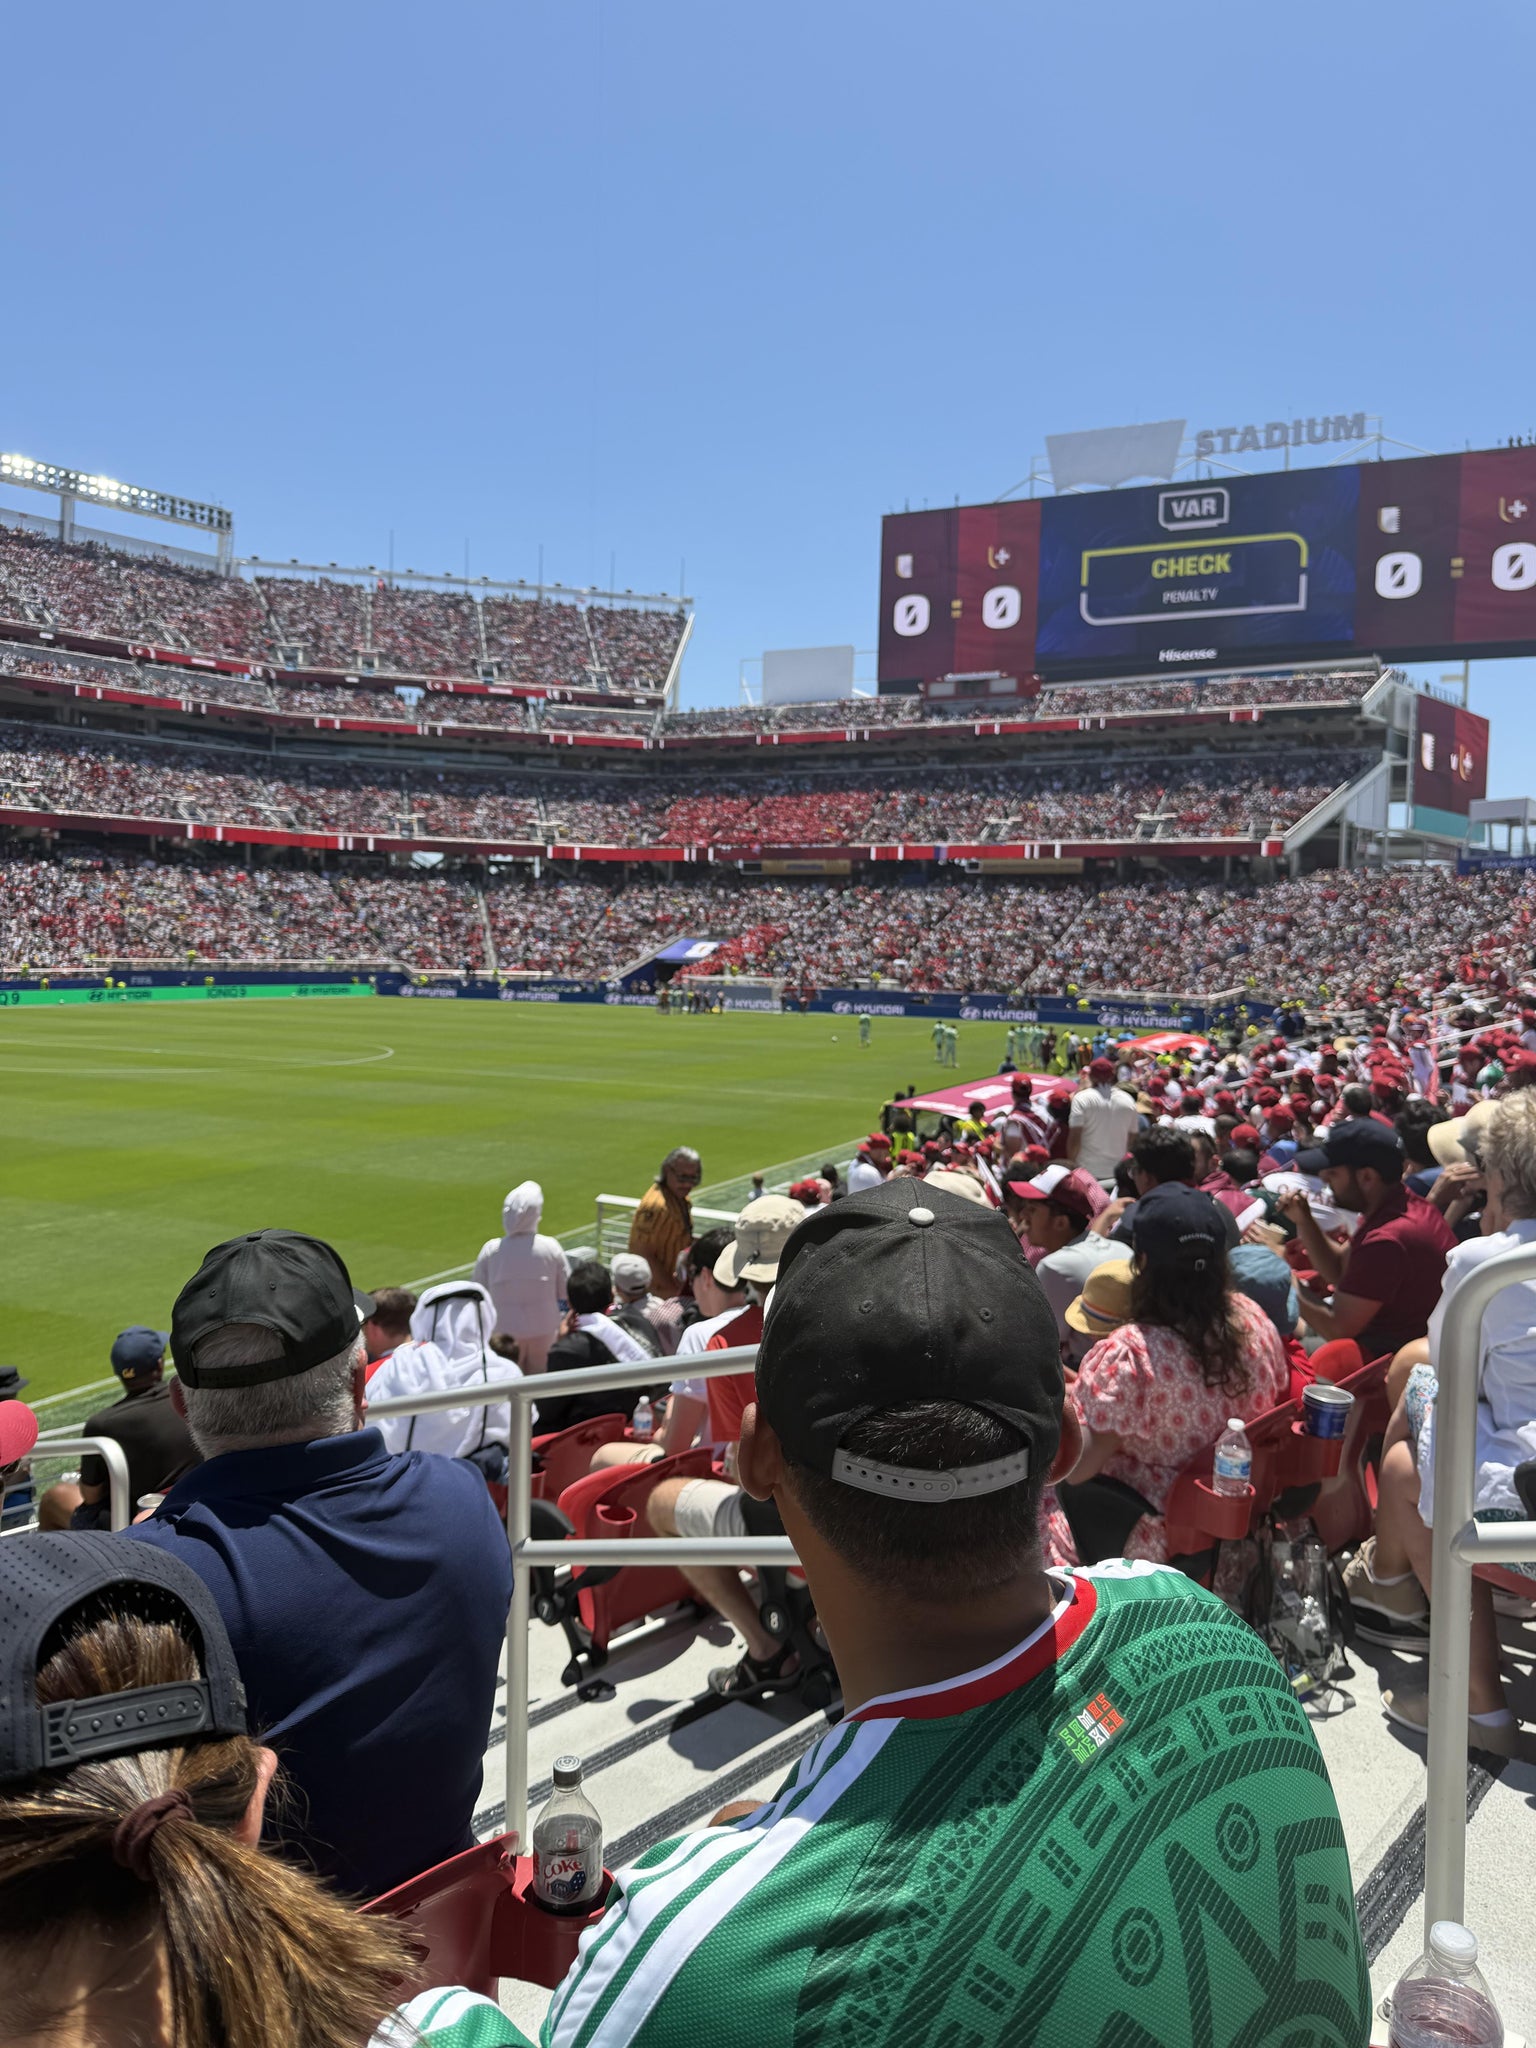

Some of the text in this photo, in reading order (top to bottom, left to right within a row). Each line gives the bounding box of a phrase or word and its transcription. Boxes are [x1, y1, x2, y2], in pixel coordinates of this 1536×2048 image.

[1196, 412, 1365, 458] STADIUM
[1171, 496, 1217, 519] VAR
[1151, 553, 1232, 579] CHECK
[1375, 541, 1536, 599] 0 0
[1162, 587, 1219, 604] PENALTY
[893, 585, 1021, 636] 0 0
[1159, 648, 1218, 662] Hisense
[416, 989, 457, 997] HYUNDAI
[517, 991, 559, 1000] HYUNDAI
[623, 995, 659, 1004] HYUND
[853, 1004, 905, 1015] HYUNDAI
[982, 1009, 1038, 1021] HYUNDAI
[1123, 1016, 1181, 1028] HYUNDAI
[770, 1611, 779, 1629] 8
[1058, 1692, 1112, 1747] SOMOS
[543, 1858, 583, 1878] Coke
